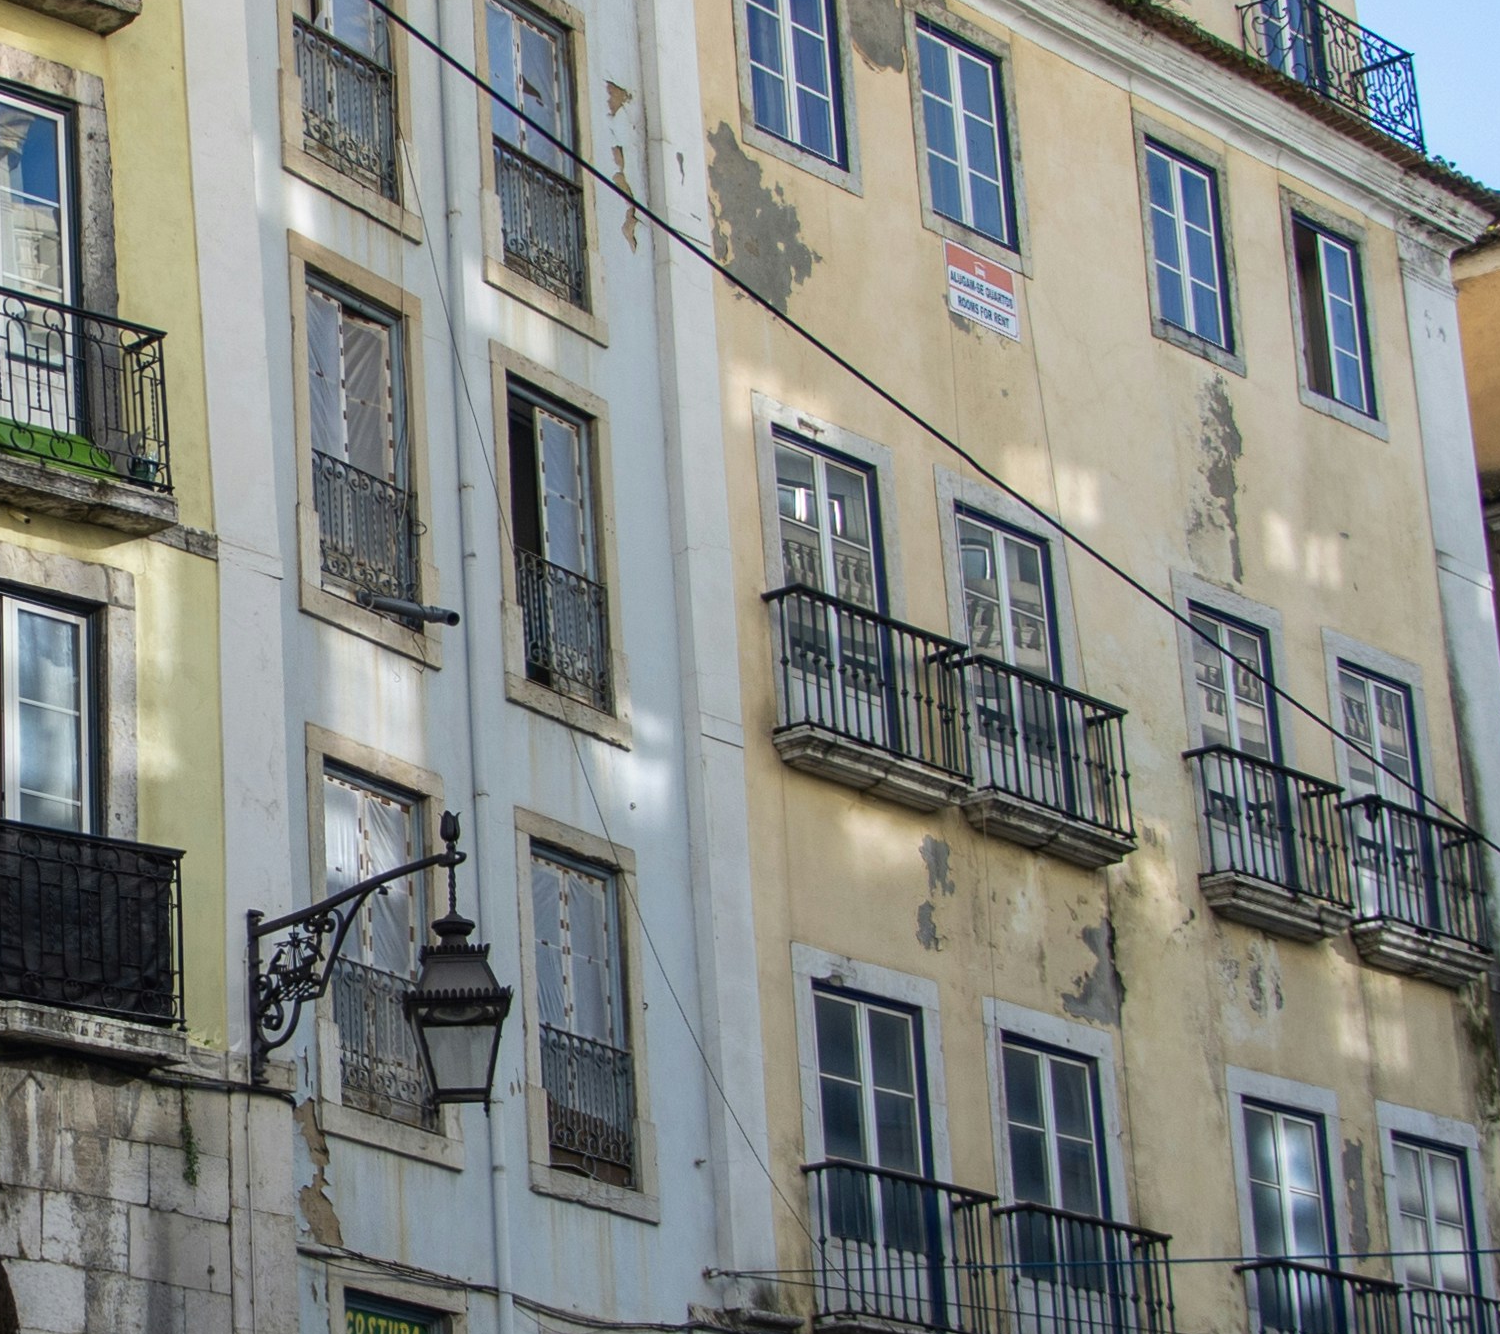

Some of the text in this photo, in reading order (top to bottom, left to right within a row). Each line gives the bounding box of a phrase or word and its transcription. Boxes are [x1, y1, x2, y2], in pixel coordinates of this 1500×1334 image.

[957, 295, 1010, 328] ROOMS FOR RENT
[985, 287, 1013, 309] QUARTOS
